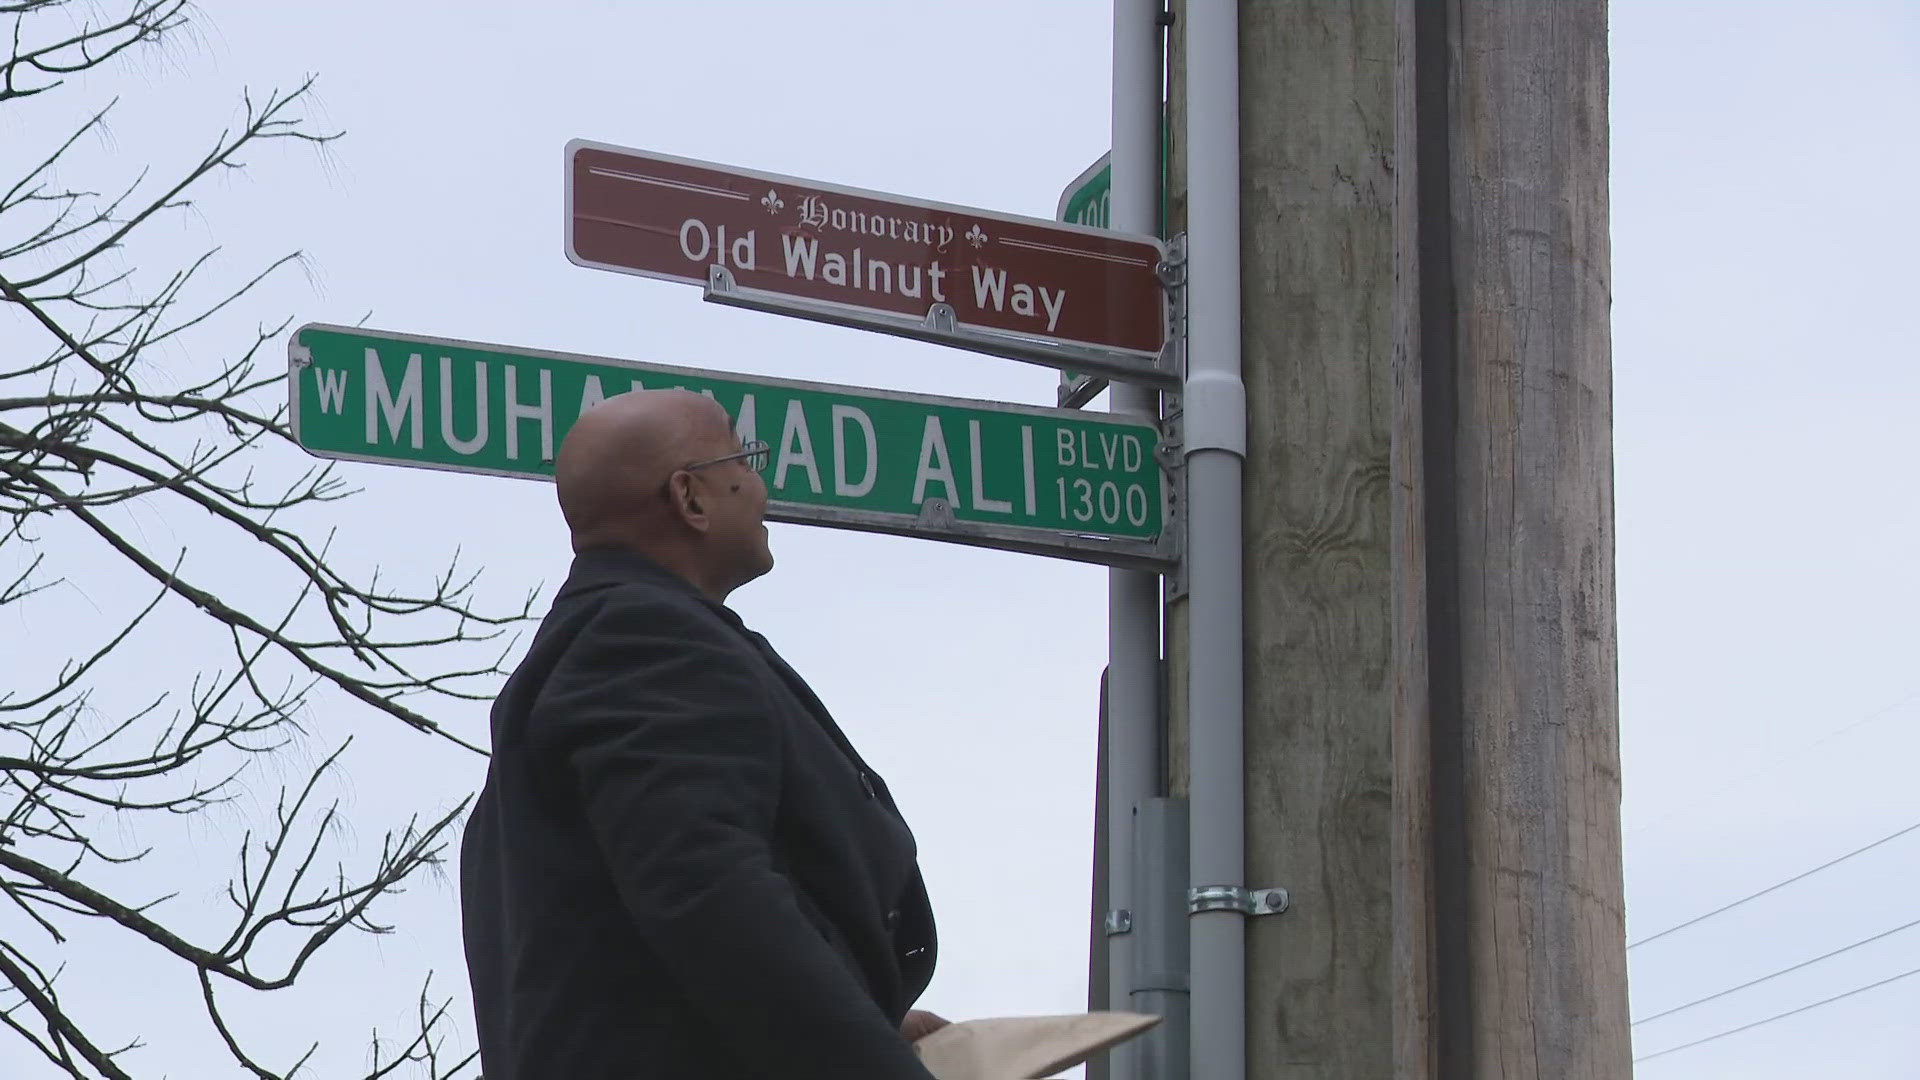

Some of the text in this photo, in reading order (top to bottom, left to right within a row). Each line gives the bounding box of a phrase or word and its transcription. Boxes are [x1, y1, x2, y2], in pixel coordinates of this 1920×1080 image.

[797, 195, 954, 254] Honorary
[679, 218, 1066, 332] Old Walnut Way
[315, 347, 1037, 516] W MUHAD ALI
[1056, 428, 1142, 473] BLVD
[1056, 476, 1148, 528] 1300
